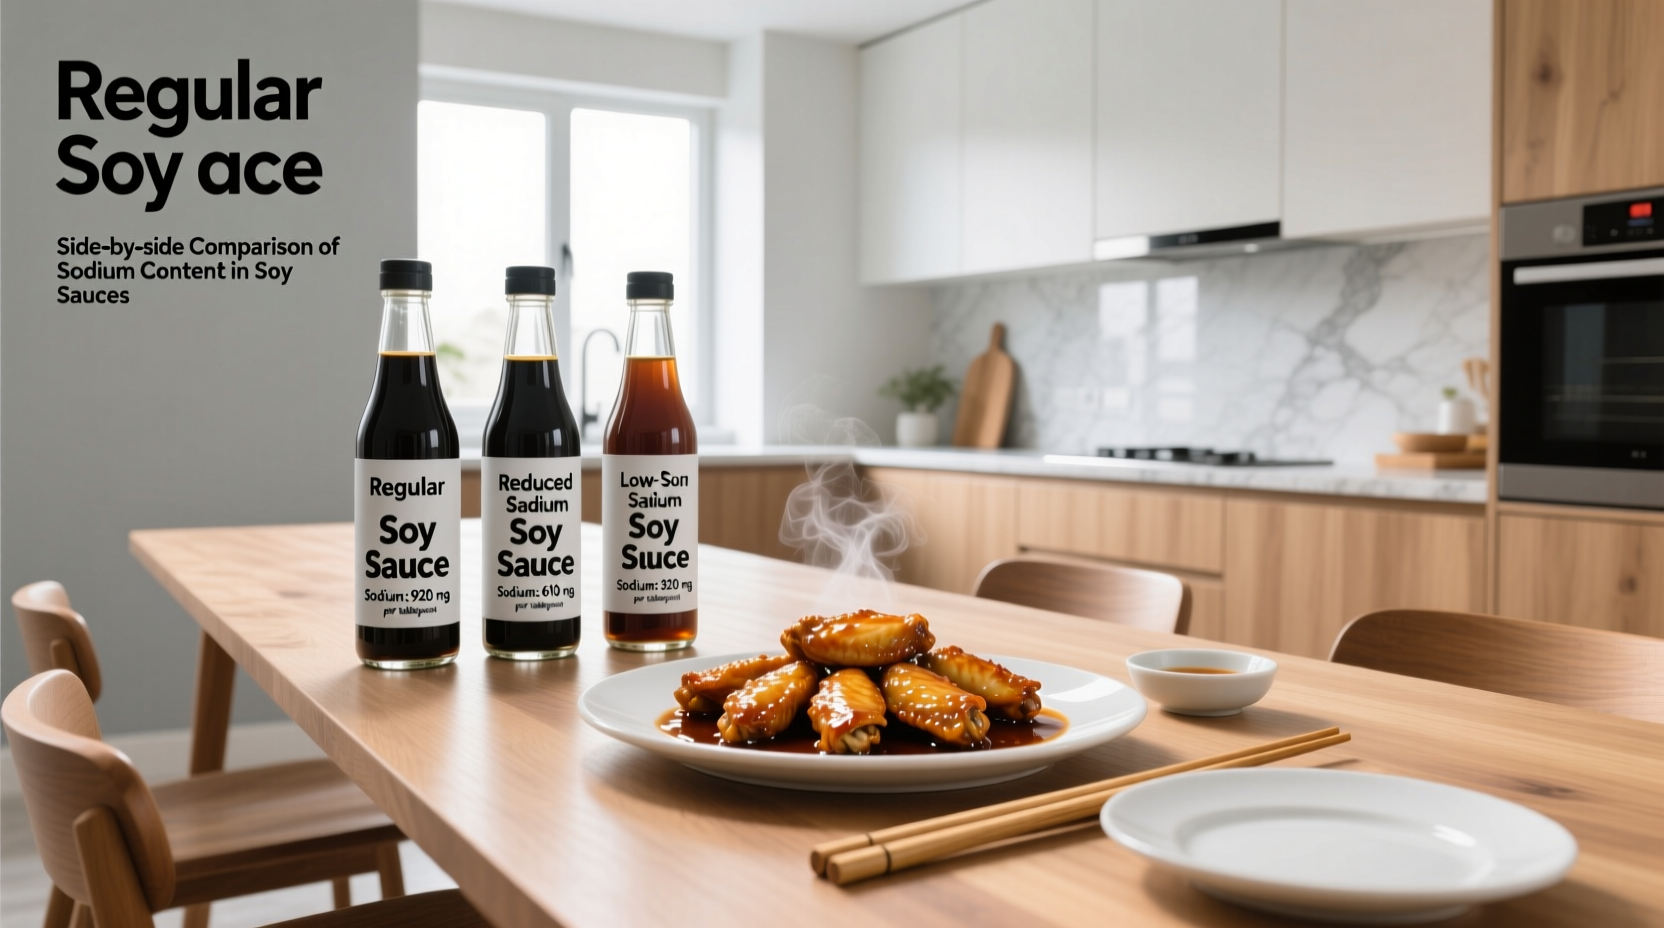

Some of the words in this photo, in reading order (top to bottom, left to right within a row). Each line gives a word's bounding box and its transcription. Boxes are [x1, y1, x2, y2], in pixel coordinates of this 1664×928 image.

[370, 476, 445, 502] Regular
[498, 472, 573, 491] Reduced
[506, 495, 569, 513] Sadium
[379, 514, 437, 551] Soy
[510, 517, 563, 552] Soy
[628, 512, 680, 546] Soy
[365, 549, 450, 579] Sauce
[497, 550, 575, 578] Sauce
[410, 588, 433, 603] 920
[541, 584, 561, 598] 610
[661, 578, 679, 591] 320
